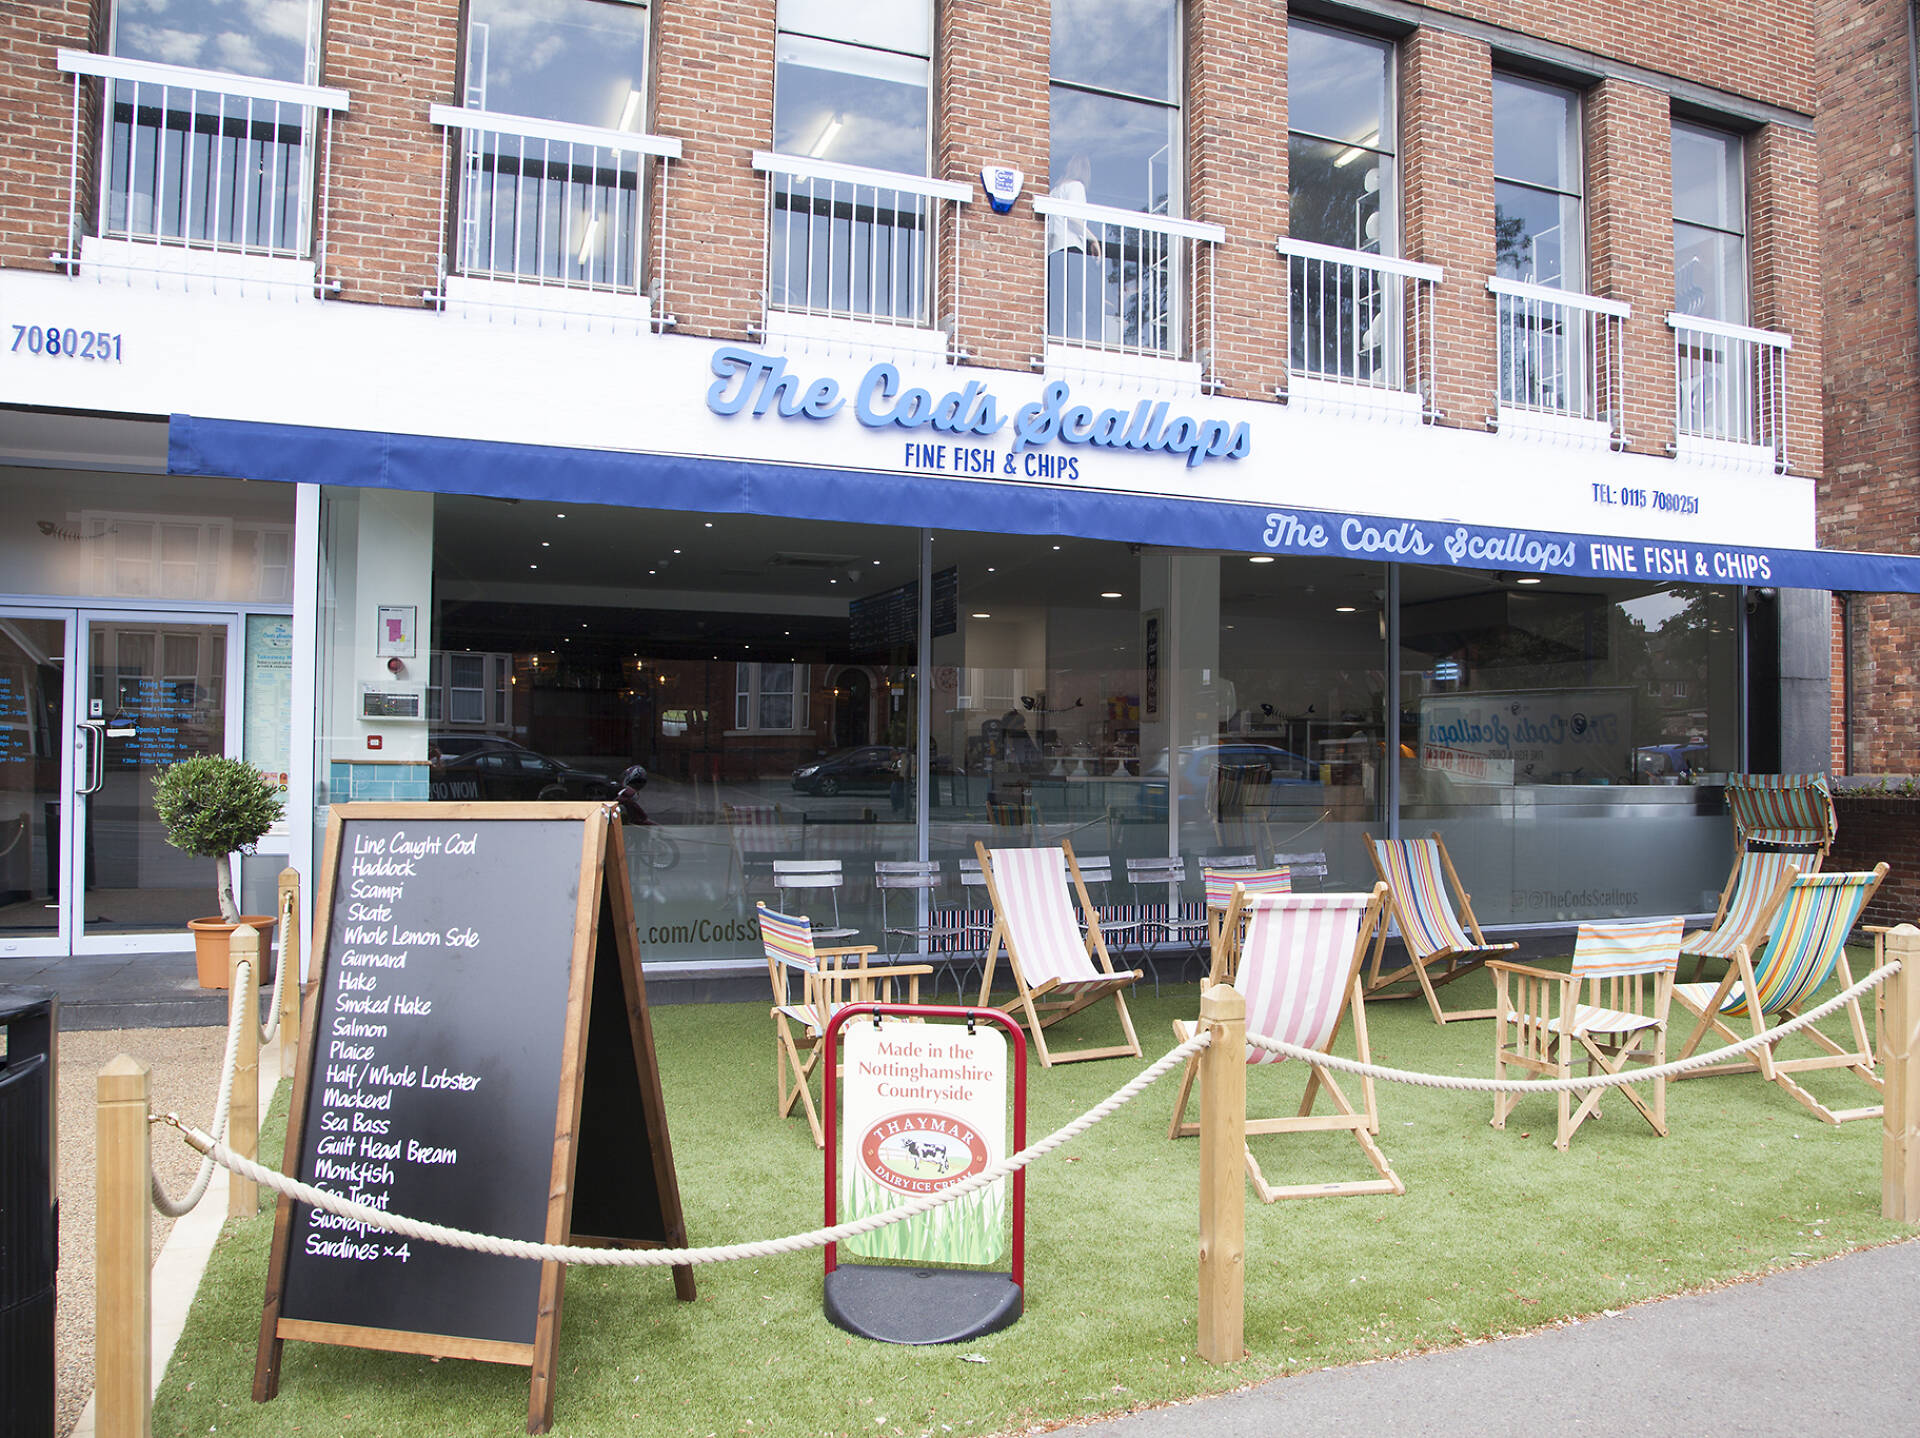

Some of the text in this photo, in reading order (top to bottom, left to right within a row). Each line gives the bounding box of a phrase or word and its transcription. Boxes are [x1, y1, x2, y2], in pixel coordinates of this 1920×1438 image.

[11, 324, 122, 361] 7080251
[707, 346, 847, 416] The
[1011, 380, 1251, 468] Scallops
[904, 442, 1079, 480] FINE FISH & CHIPS
[1591, 482, 1699, 514] TEL: 0115 7080251
[1263, 512, 1576, 571] The Cod's Scallops
[1589, 543, 1771, 580] FINE FISH & CHIPS
[139, 680, 176, 690] Frying Times
[136, 725, 178, 735] Opening Times
[354, 831, 478, 859] Line Caught Cod
[352, 857, 416, 877] Haddock
[350, 879, 404, 903] Scampi
[348, 903, 392, 922] Skate
[344, 925, 480, 948] Whole Lemon Sole
[340, 949, 408, 969] Gurnard
[338, 971, 377, 991] Hake
[335, 993, 432, 1016] Smoked Hake
[332, 1017, 388, 1038] Salmon
[329, 1040, 375, 1061] Plaice
[878, 1041, 974, 1060] Made in the
[421, 1065, 482, 1091] Lobster
[858, 1061, 993, 1082] Nottinghamshire
[322, 1088, 393, 1110] Mackerel
[877, 1082, 973, 1104] Countryside
[320, 1111, 391, 1134] Sea Bass
[873, 1117, 975, 1146] THAYMAR
[360, 1136, 402, 1160] Head
[407, 1139, 457, 1164] Bream
[314, 1158, 395, 1188] Monkfish
[875, 1166, 911, 1188] DAIRY
[912, 1181, 931, 1191] ICE
[305, 1233, 380, 1261] Sardines
